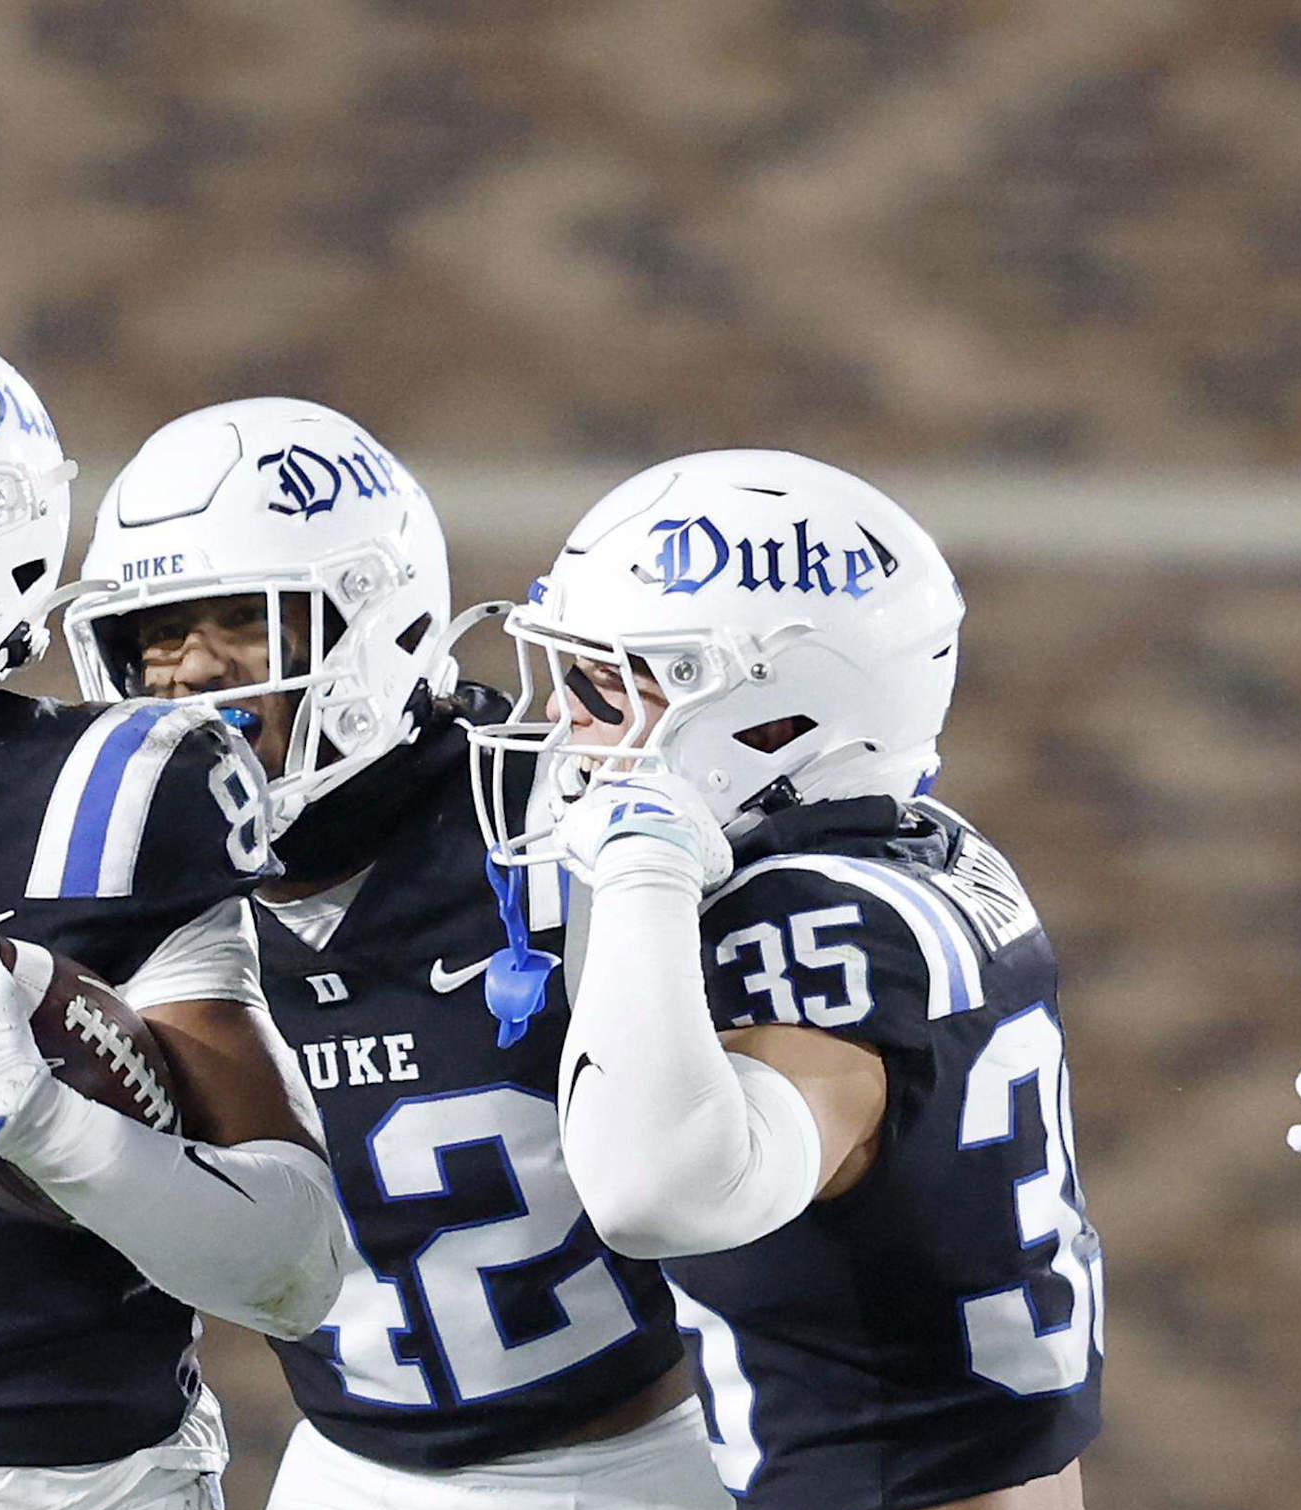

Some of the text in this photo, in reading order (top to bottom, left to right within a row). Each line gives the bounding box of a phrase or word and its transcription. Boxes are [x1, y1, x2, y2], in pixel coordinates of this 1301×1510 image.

[122, 553, 185, 583] DUKE
[632, 515, 876, 600] Duke
[208, 752, 269, 874] 8
[306, 973, 350, 1004] D
[714, 902, 876, 1030] 35
[302, 1033, 420, 1090] UKE
